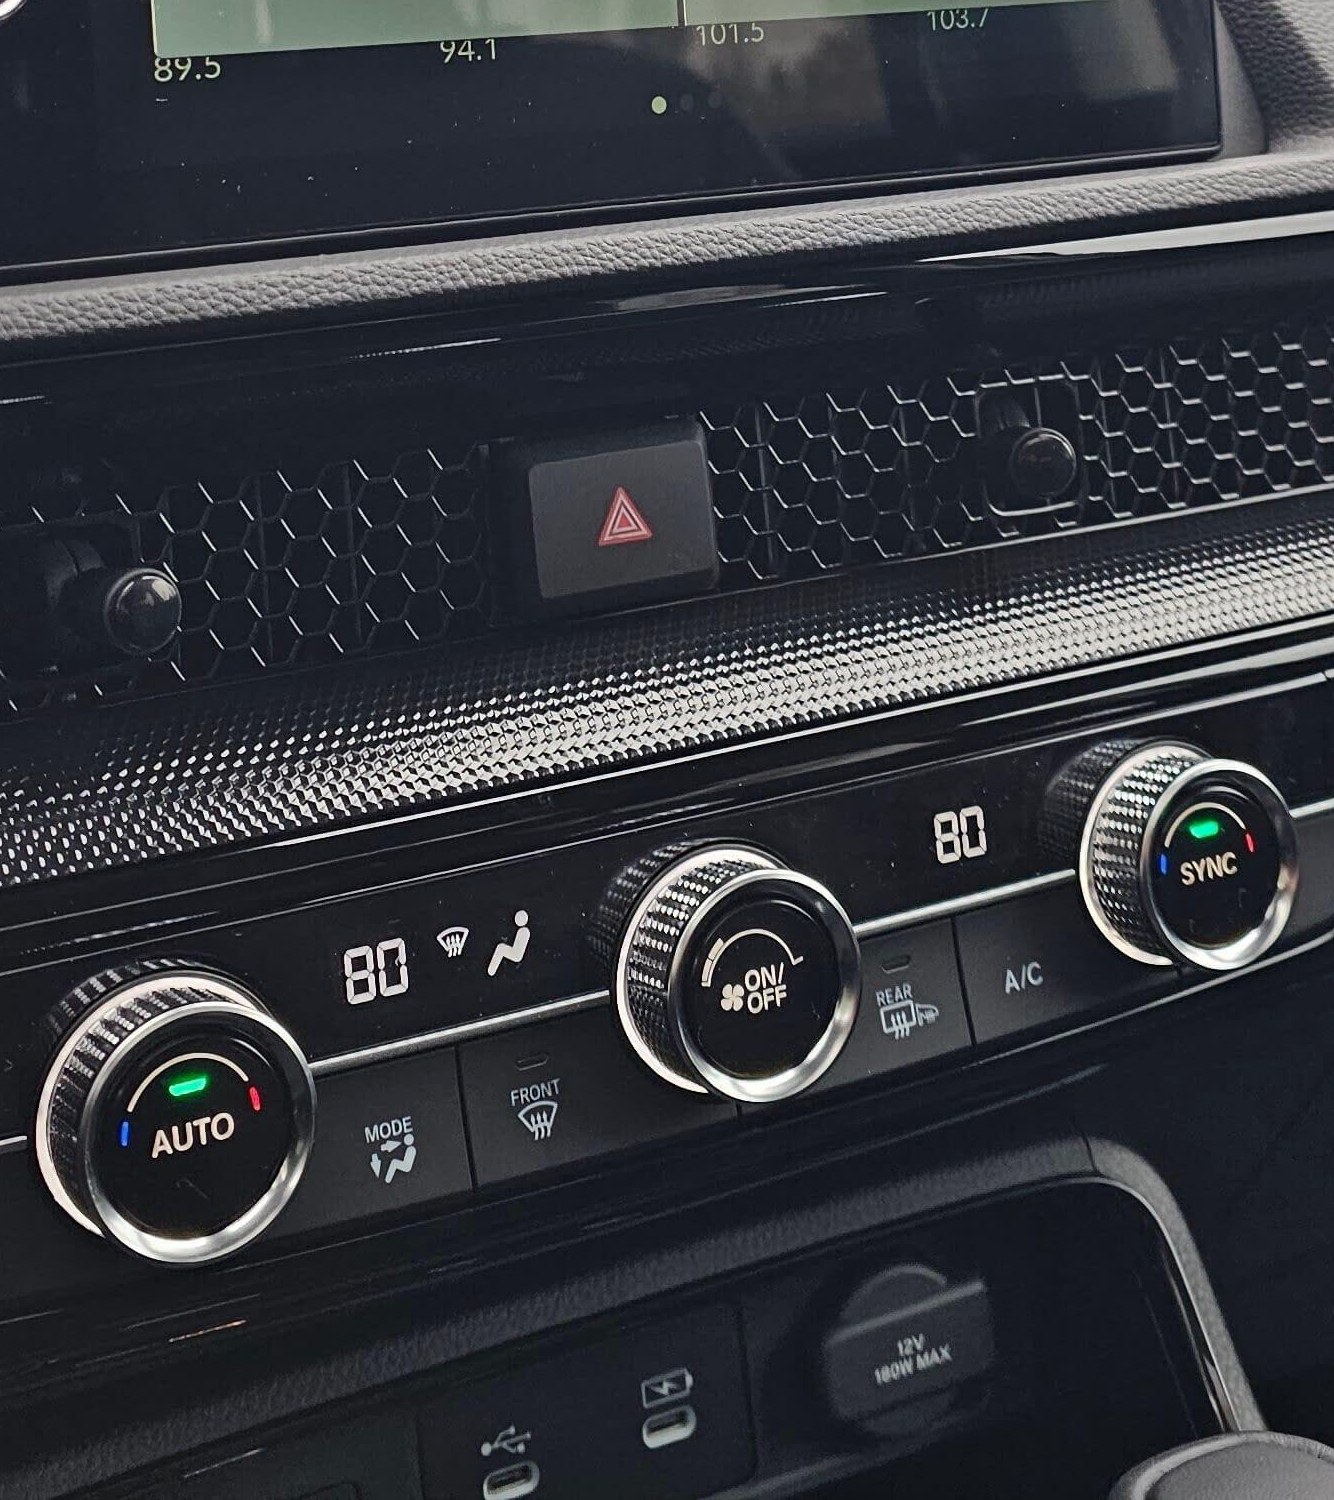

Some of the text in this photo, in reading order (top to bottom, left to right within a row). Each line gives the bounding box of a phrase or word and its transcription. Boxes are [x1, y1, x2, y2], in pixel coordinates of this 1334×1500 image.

[696, 23, 764, 46] 101.5
[439, 39, 496, 63] 94.1
[154, 57, 221, 82] 89.5
[933, 805, 988, 864] 80
[1181, 852, 1238, 886] SYNC
[343, 937, 409, 1005] 80
[744, 963, 785, 990] ON/
[1004, 962, 1043, 995] A/C
[747, 988, 788, 1014] OFF
[876, 984, 913, 1007] REAR
[510, 1078, 561, 1106] FRONT
[151, 1113, 235, 1159] AUTO
[364, 1116, 413, 1143] MODE
[897, 1333, 925, 1357] 12V
[917, 1343, 953, 1371] MAX
